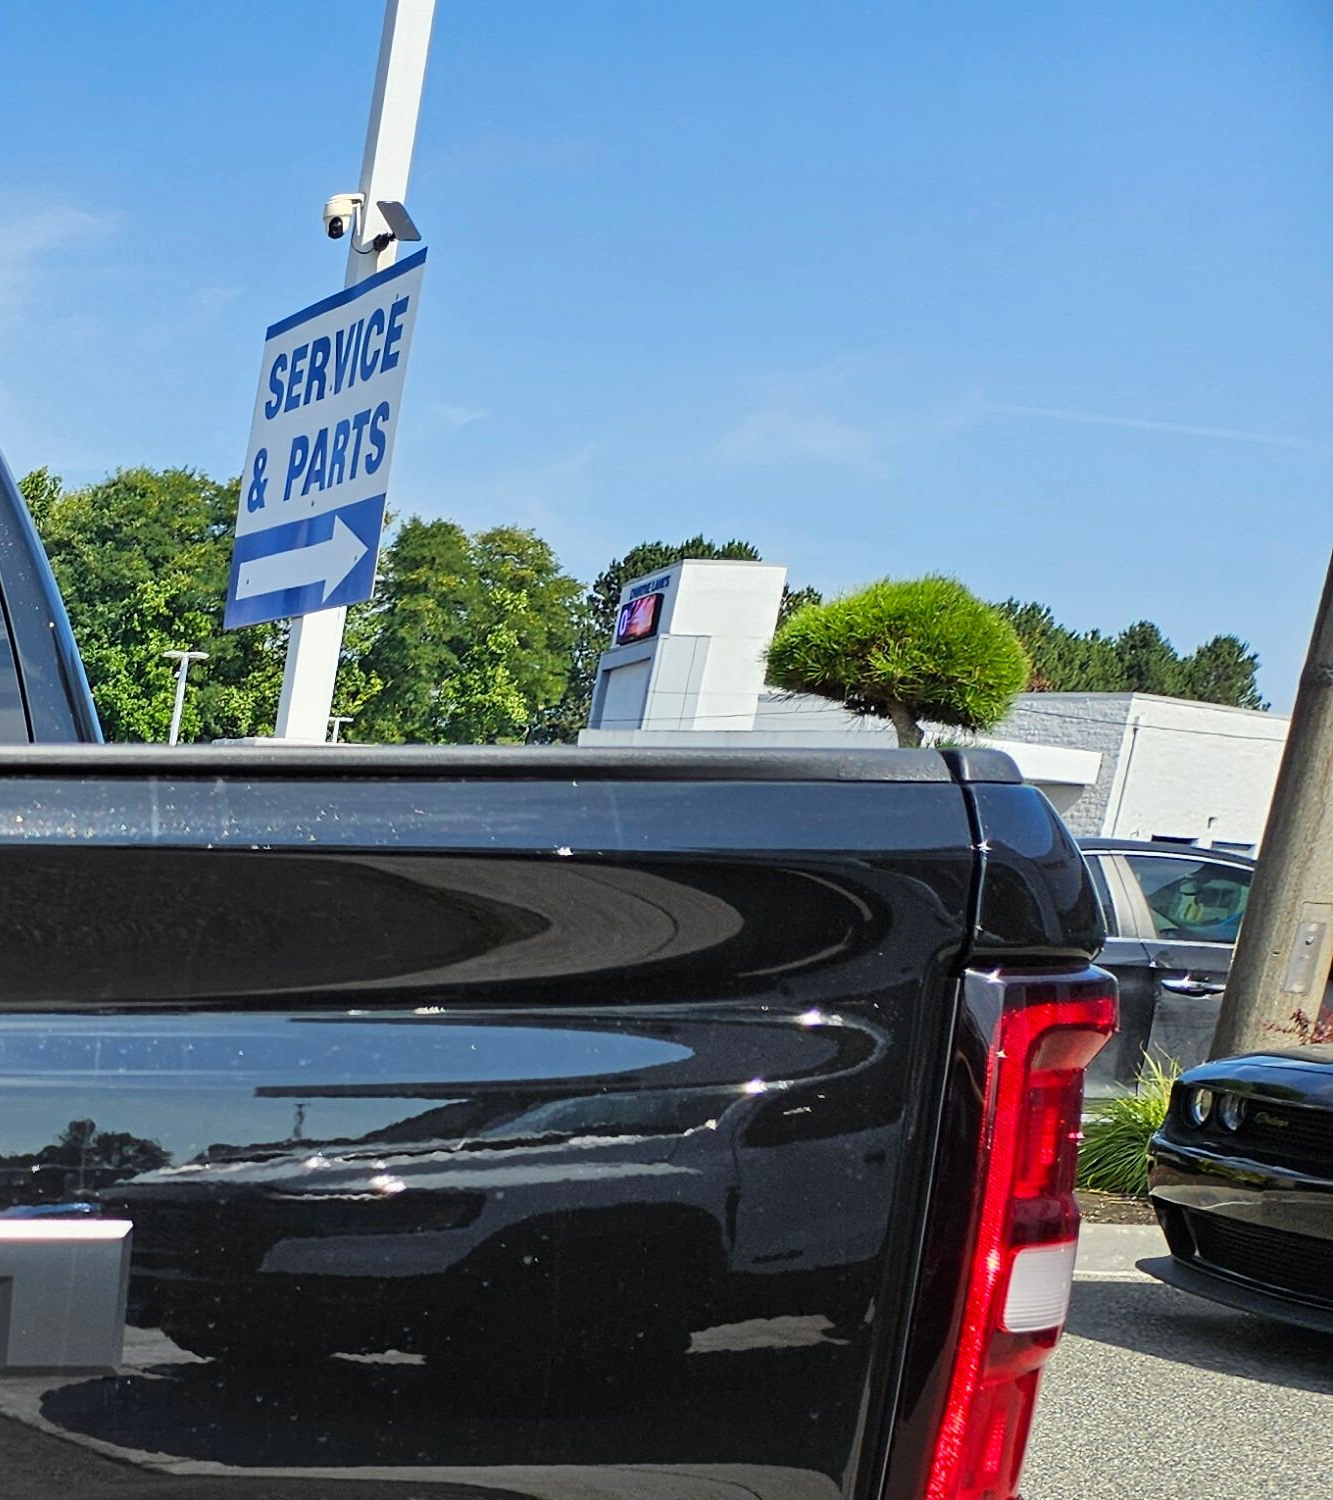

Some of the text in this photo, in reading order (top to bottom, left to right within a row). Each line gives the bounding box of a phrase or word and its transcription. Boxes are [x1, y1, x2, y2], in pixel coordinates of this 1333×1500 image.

[265, 295, 409, 420] SERVICE
[247, 401, 390, 513] & PARTS
